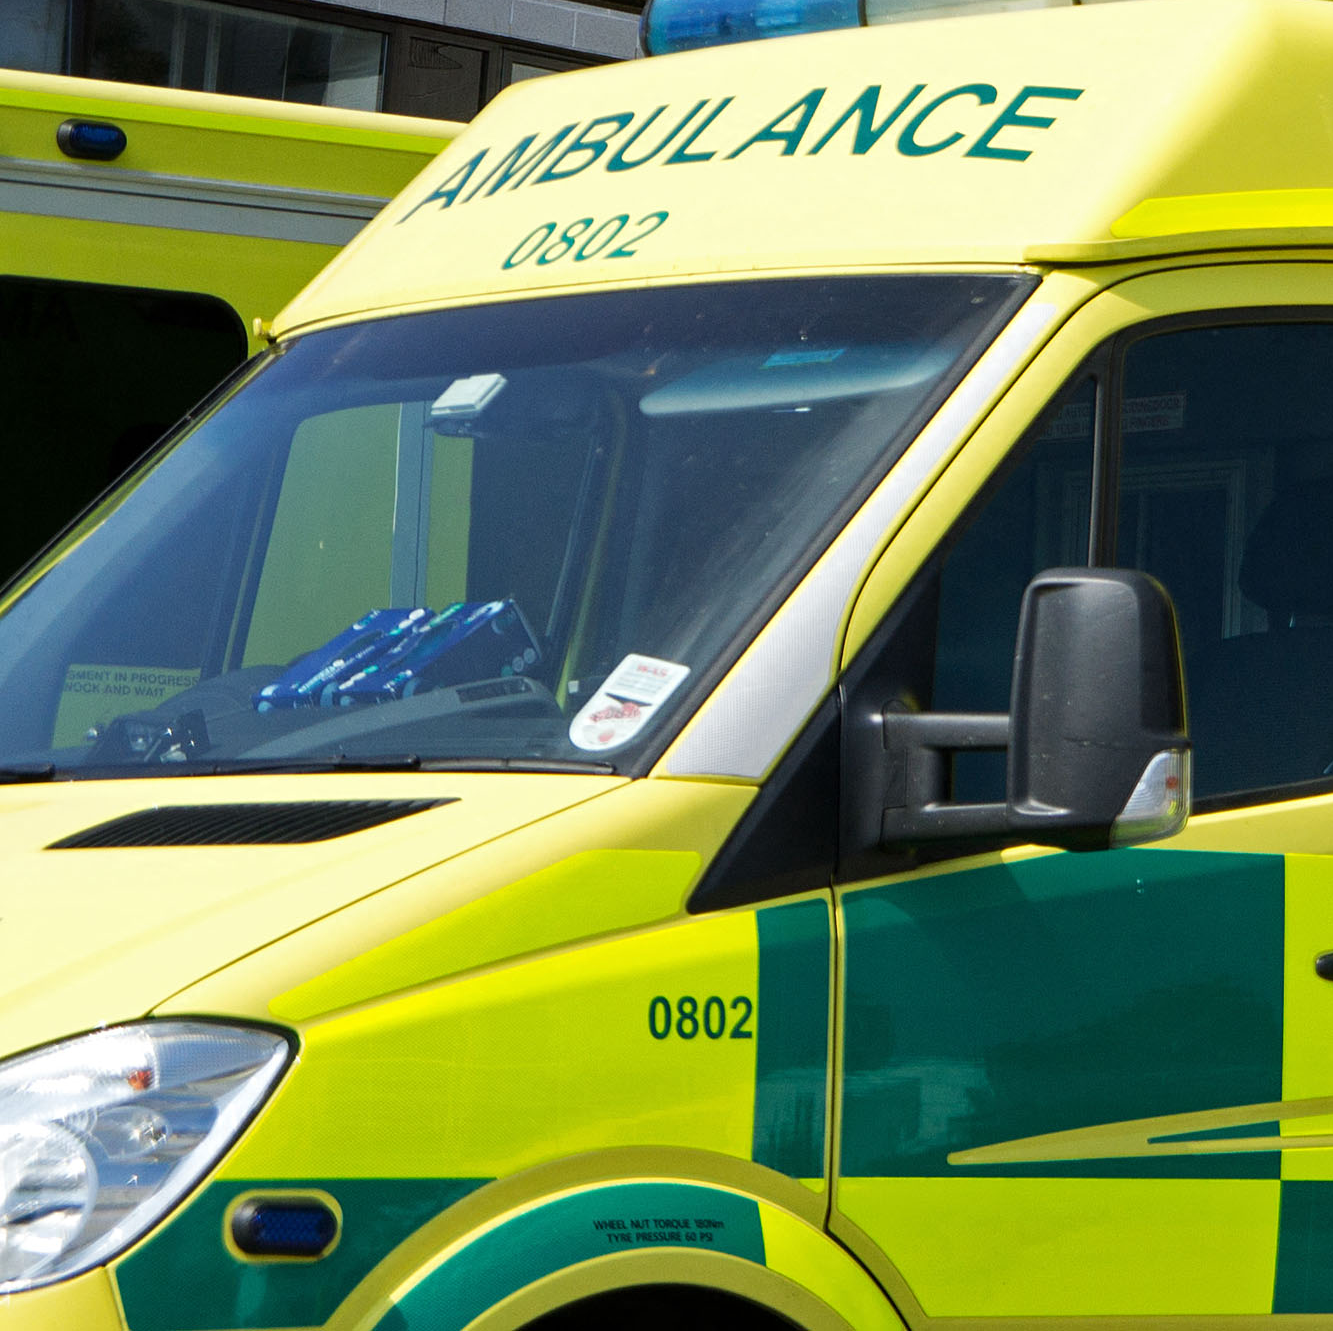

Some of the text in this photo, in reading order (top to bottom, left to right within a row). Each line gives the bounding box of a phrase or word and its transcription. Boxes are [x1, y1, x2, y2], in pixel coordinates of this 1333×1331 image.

[400, 83, 1085, 223] AMBULANCE
[502, 210, 669, 271] 0802
[648, 995, 753, 1040] 0802
[593, 1220, 627, 1230] WHEEL
[631, 1220, 649, 1229] NUT
[653, 1219, 691, 1230] TORQUE
[607, 1232, 632, 1243] TYRE
[636, 1231, 681, 1242] PRESSURE
[700, 1232, 713, 1242] PSI
